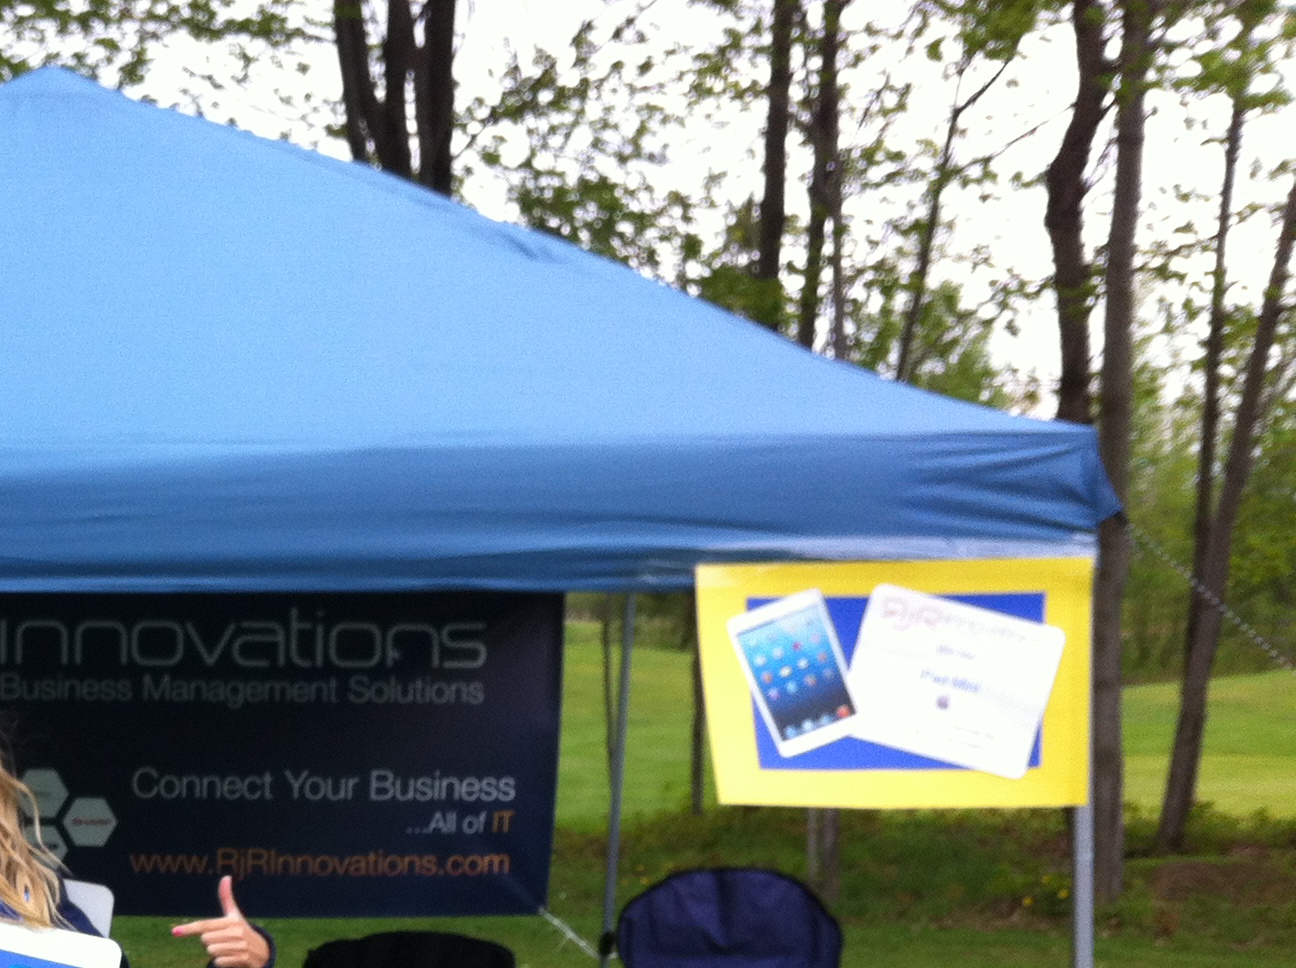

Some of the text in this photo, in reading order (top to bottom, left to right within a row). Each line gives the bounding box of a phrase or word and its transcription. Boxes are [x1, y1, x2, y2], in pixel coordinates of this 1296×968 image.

[142, 674, 337, 709] Management
[348, 675, 485, 705] Solutions
[131, 766, 516, 803] Connect Your Business
[462, 811, 488, 835] of
[491, 810, 515, 834] IT
[130, 847, 511, 881] www.RjRInnovations.com
